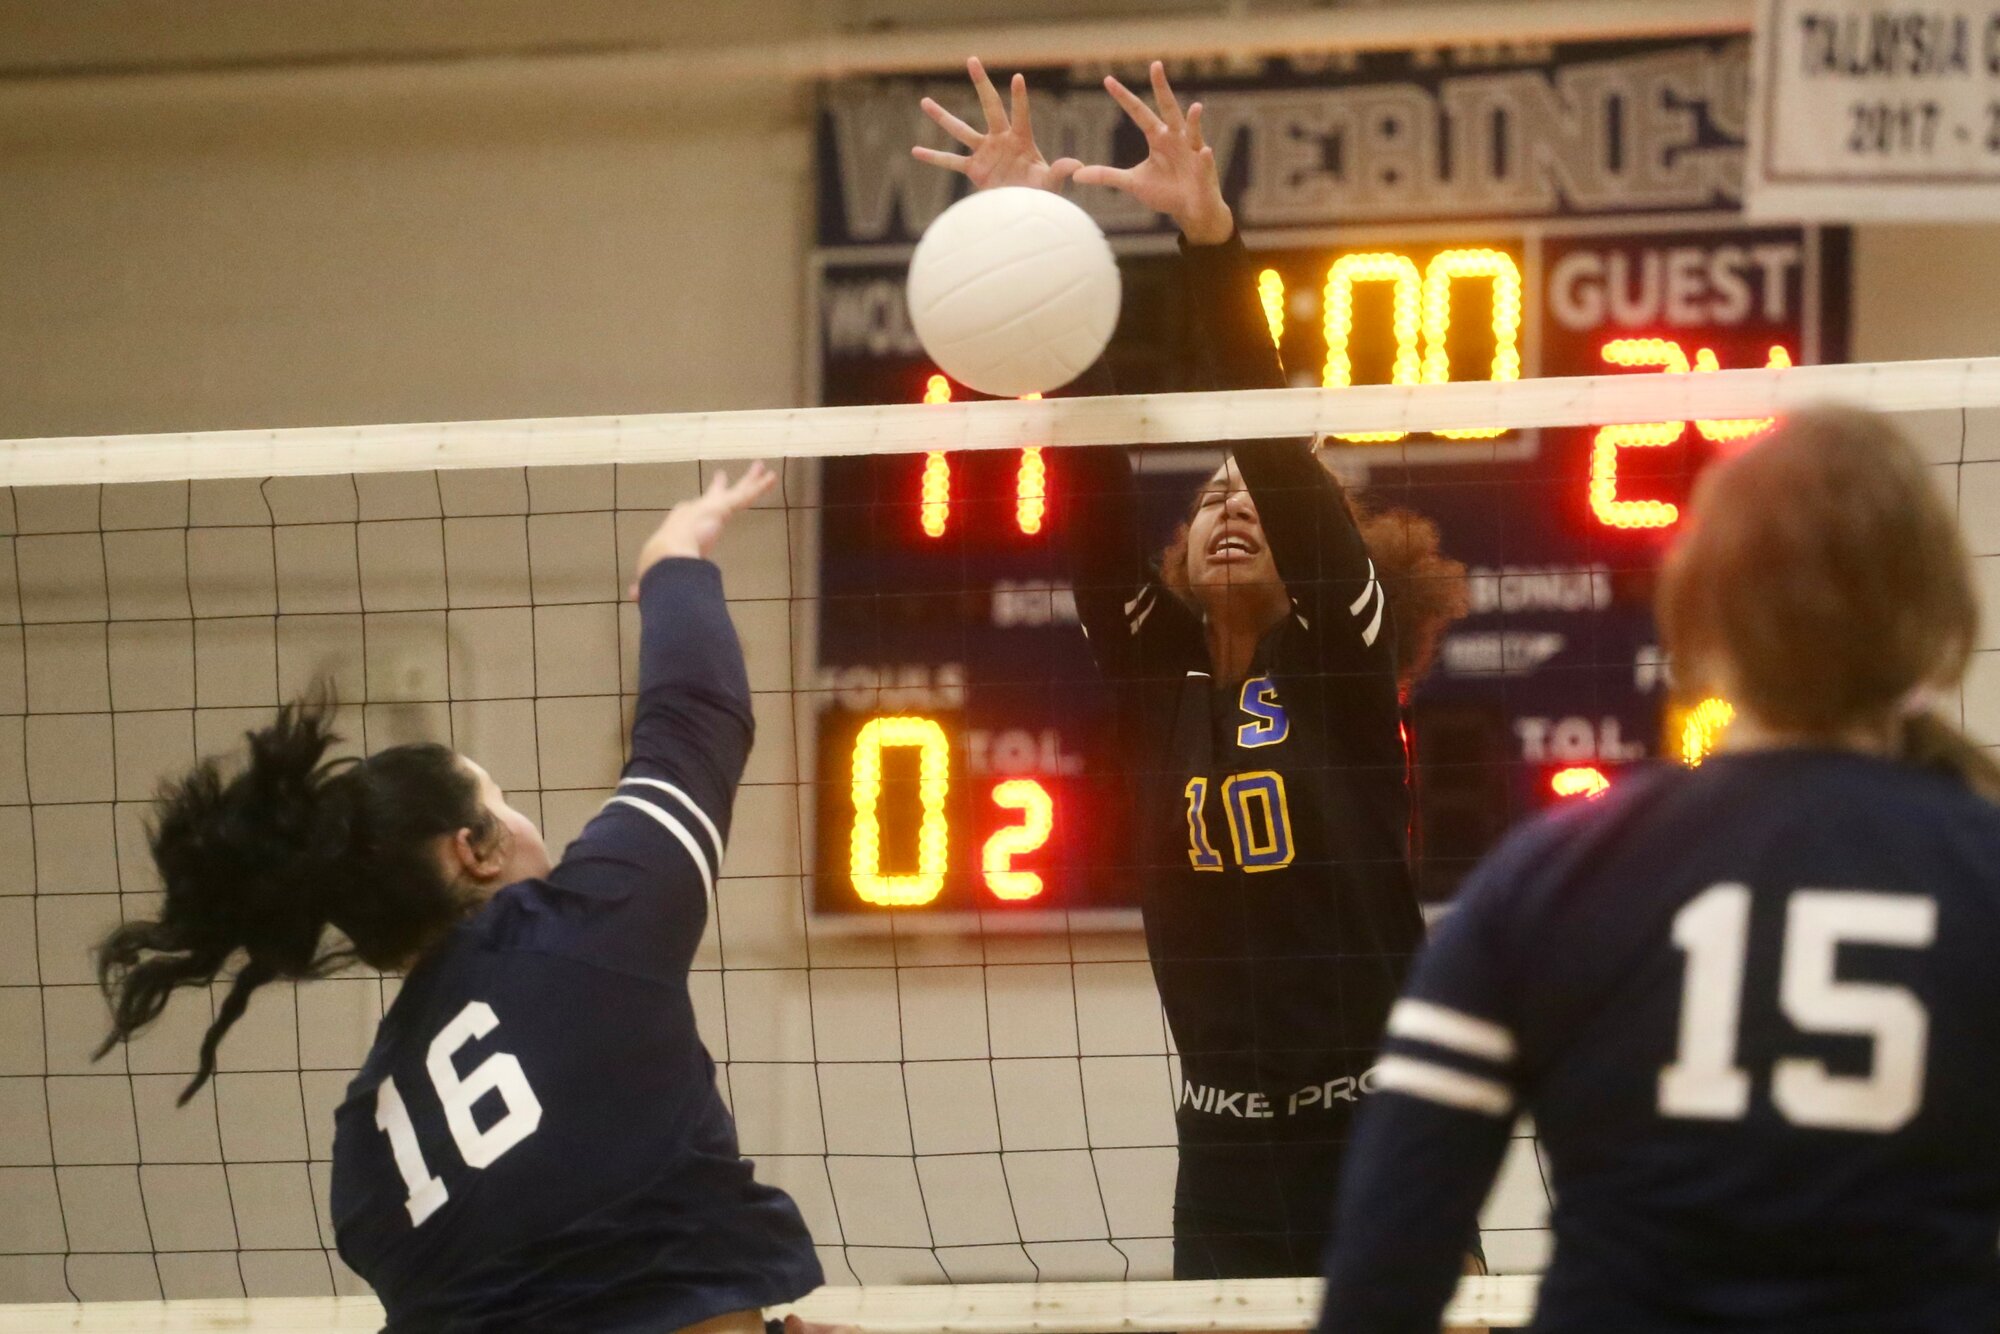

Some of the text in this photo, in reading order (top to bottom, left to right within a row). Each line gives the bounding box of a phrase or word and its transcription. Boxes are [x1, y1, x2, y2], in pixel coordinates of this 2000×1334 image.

[1549, 245, 1797, 330] GUEST
[1237, 677, 1290, 748] S
[850, 716, 949, 906] 0
[982, 779, 1054, 900] 2
[1184, 770, 1295, 873] 10
[1657, 881, 1939, 1134] 15
[375, 1001, 543, 1228] 16
[1182, 1080, 1275, 1118] NIKE
